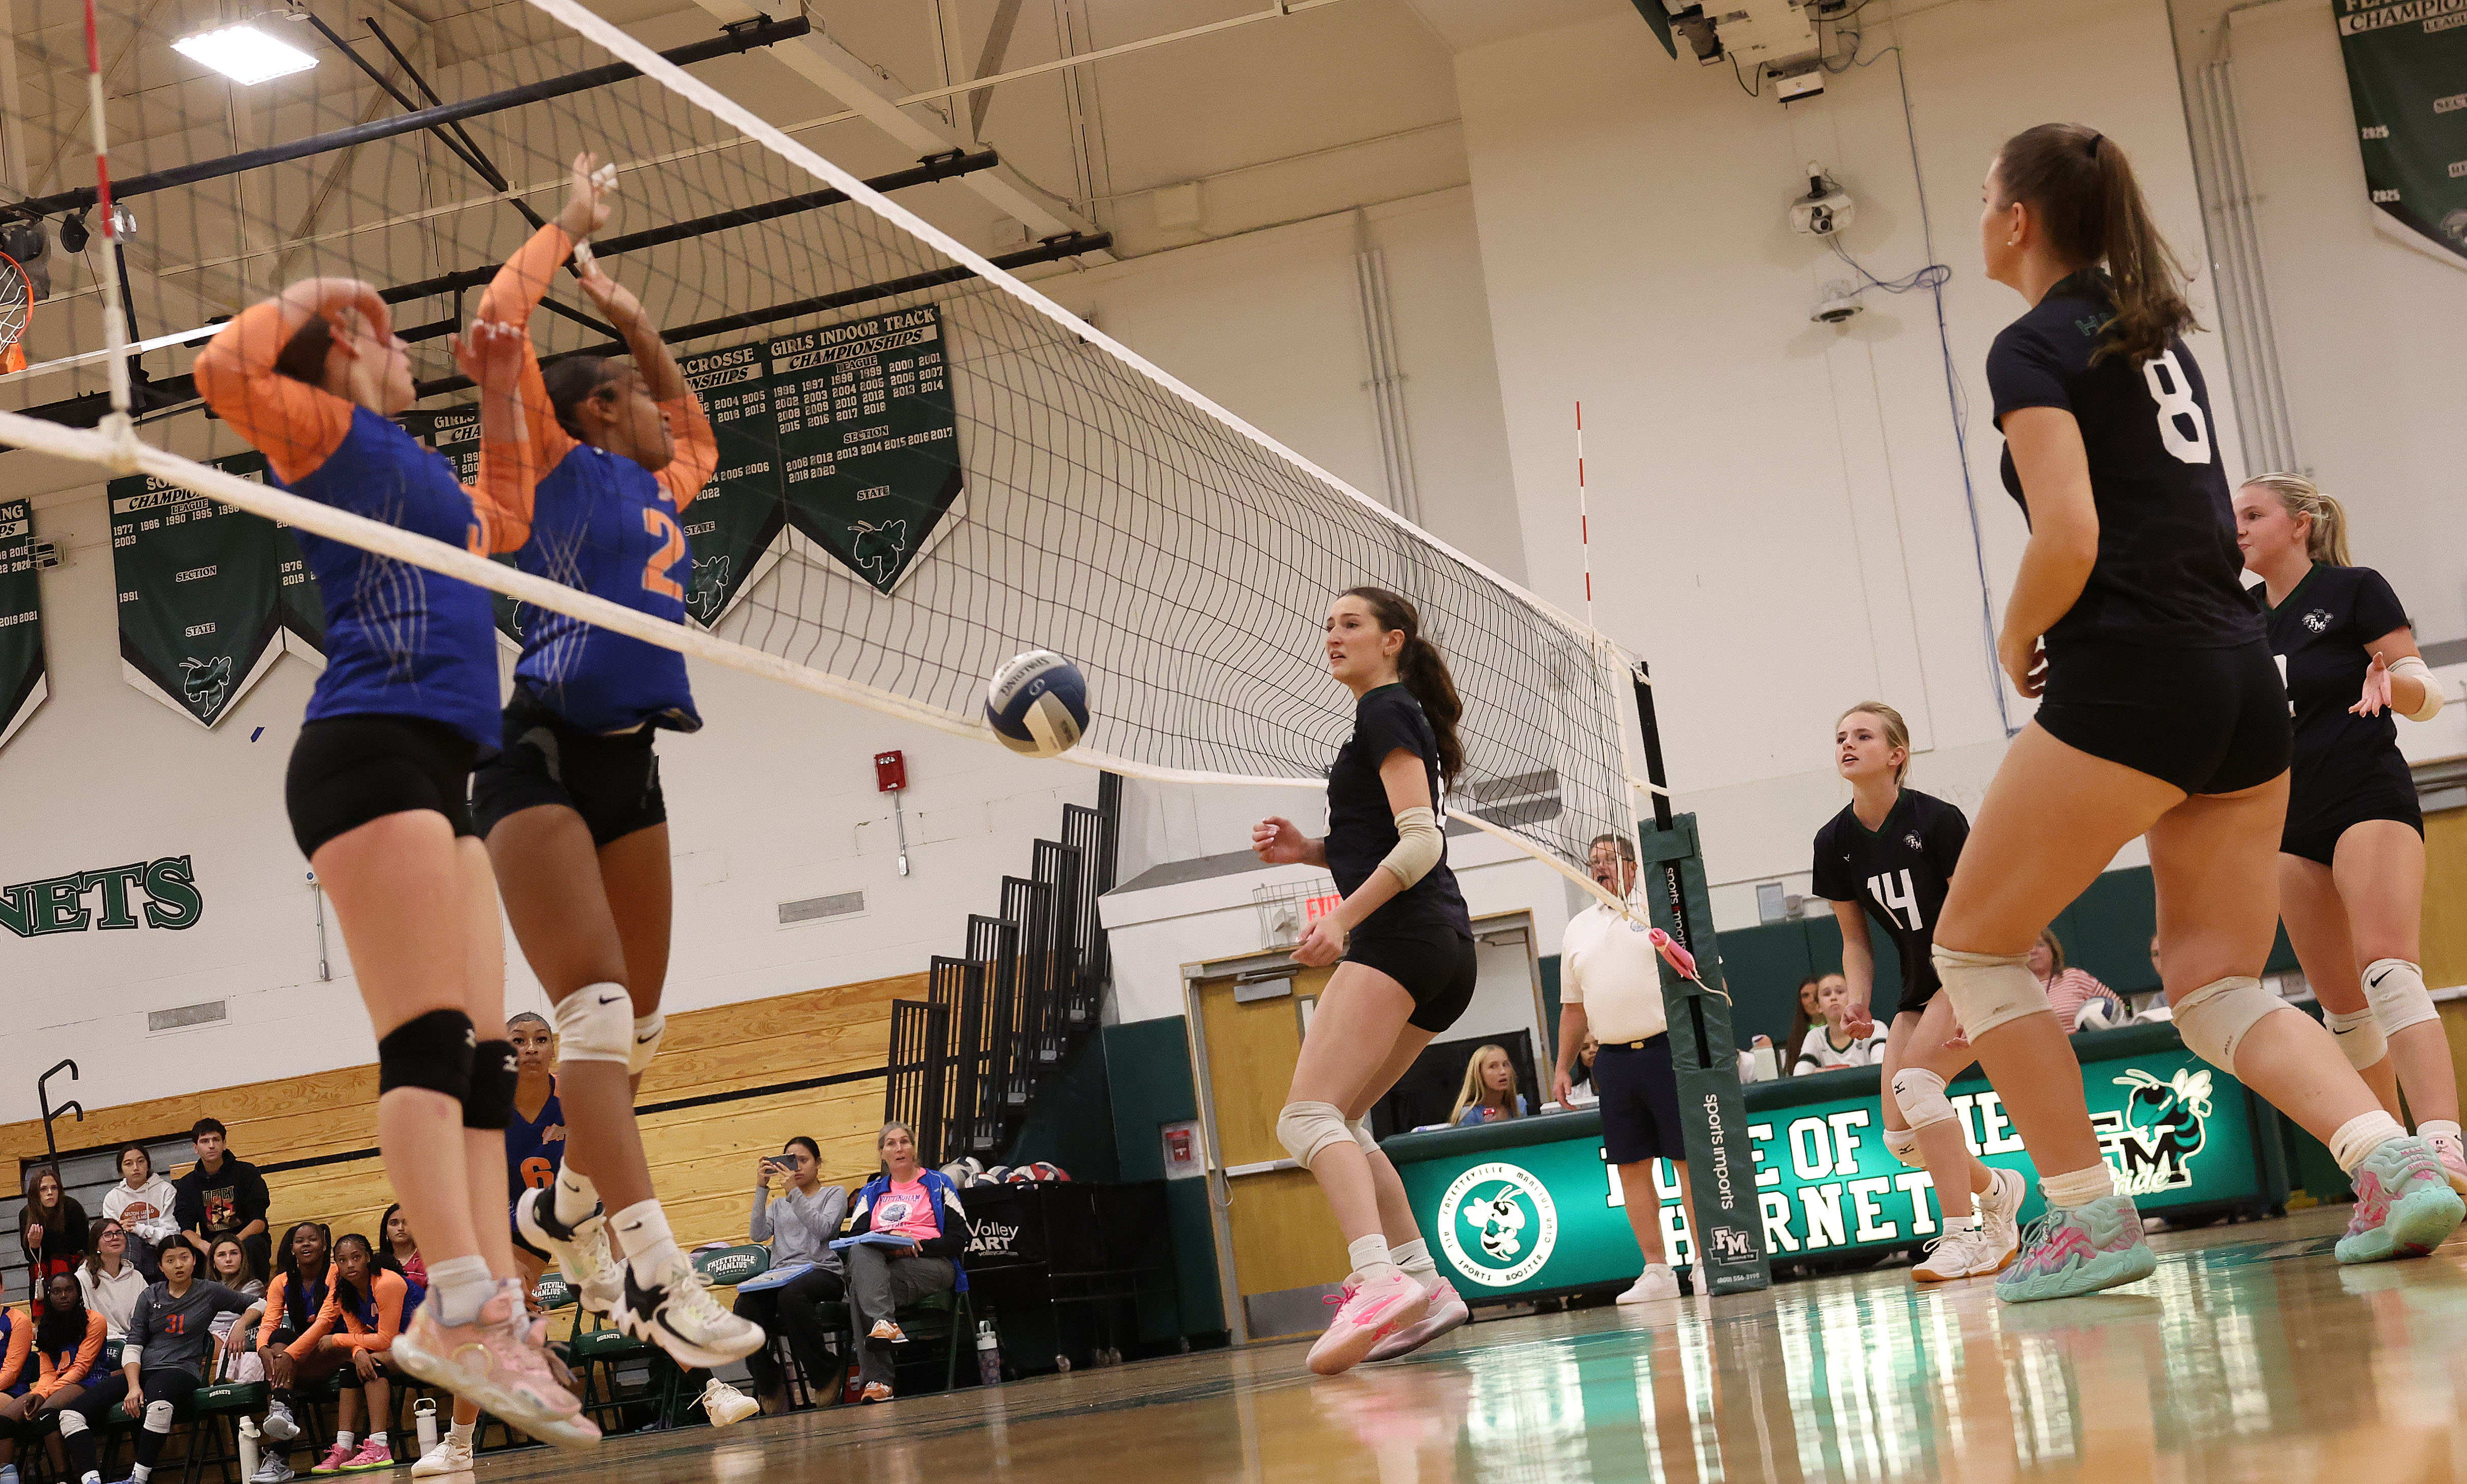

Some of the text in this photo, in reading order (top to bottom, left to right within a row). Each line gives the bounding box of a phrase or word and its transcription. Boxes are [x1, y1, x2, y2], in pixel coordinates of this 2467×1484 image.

[2350, 0, 2467, 31] CHAMPIO
[771, 308, 936, 356] GIRLS INDOOR TRACK
[790, 329, 924, 369] CHAMPIONSHIPS
[678, 348, 754, 376] ACROSSE
[836, 355, 878, 373] LEAGUE
[773, 352, 941, 397] 1996 1997 1998 1999 2000 2001
[775, 396, 799, 409] 2002
[803, 390, 828, 404] 2003
[832, 383, 857, 398] 2004
[860, 378, 884, 391] 2005
[919, 366, 943, 380] 2007
[715, 396, 739, 409] 2004
[742, 390, 766, 404] 2005
[777, 379, 943, 422] 2008 2009 2010 2012 2013 2014
[2142, 349, 2211, 464] 8
[745, 403, 766, 417] 2019
[779, 401, 886, 434] 2015 2016 2017 2018
[843, 426, 889, 444] SECTION
[462, 452, 481, 463] 199
[786, 427, 953, 472] 2008 2012 2013 2014 2015 2016 2017
[721, 467, 743, 481] 2005
[745, 462, 769, 474] 2006
[789, 465, 836, 483] 2018 2020
[857, 485, 890, 501] STATE
[171, 499, 208, 515] LEAGUE
[114, 524, 133, 536] 1977
[140, 519, 160, 531] 1986
[166, 514, 186, 526] 1990
[192, 508, 213, 521] 1995
[684, 521, 715, 536] STATE
[115, 535, 136, 548] 2003
[642, 508, 685, 602] 2
[176, 565, 217, 582] SECTION
[281, 560, 302, 573] 1976
[283, 573, 304, 586] 2019
[119, 591, 139, 603] 1991
[19, 610, 38, 622] 2021
[185, 622, 216, 637] STATE
[1666, 867, 1679, 905] sports
[0, 855, 203, 938] NETS
[1867, 869, 1923, 931] 14
[1703, 1093, 1724, 1145] sports
[1787, 1110, 1870, 1181] OF
[520, 1157, 554, 1189] 6
[966, 1218, 1019, 1240] Volley
[964, 1236, 1011, 1252] ART
[716, 1262, 747, 1273] MANLIUS
[1459, 1260, 1491, 1281] SPORTS
[1506, 1254, 1543, 1281] BOOSTER
[165, 1314, 184, 1334] 31
[596, 1333, 620, 1342] HORNETS
[209, 1389, 231, 1397] HORNETS
